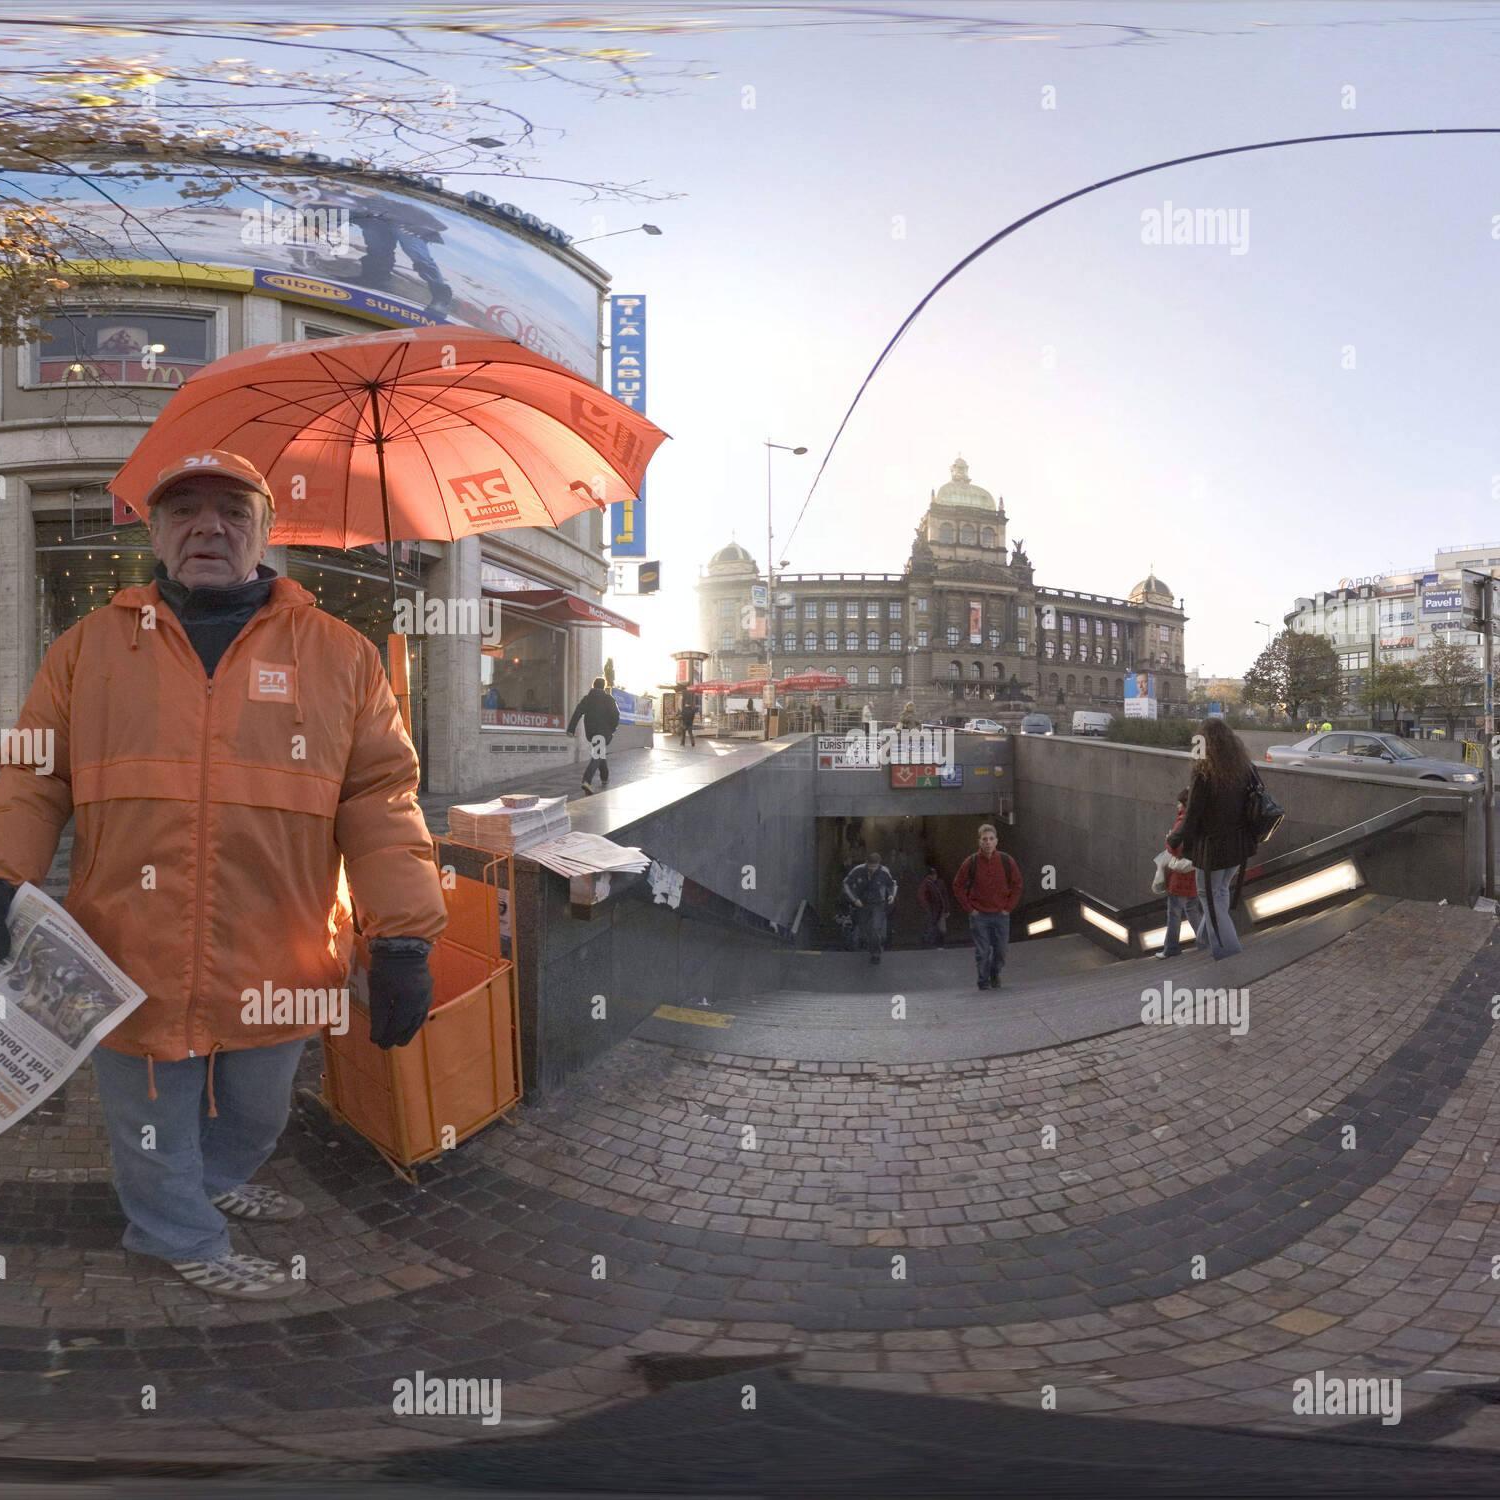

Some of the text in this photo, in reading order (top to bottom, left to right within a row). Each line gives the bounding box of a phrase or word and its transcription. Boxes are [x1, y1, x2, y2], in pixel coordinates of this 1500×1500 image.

[272, 278, 343, 298] albert
[184, 454, 221, 468] 24
[1425, 598, 1452, 608] Pavel
[502, 714, 548, 726] NONSTOP
[924, 767, 932, 775] C
[924, 777, 932, 786] A
[18, 1052, 30, 1062] i
[25, 1057, 54, 1082] hrát
[26, 1083, 40, 1094] V
